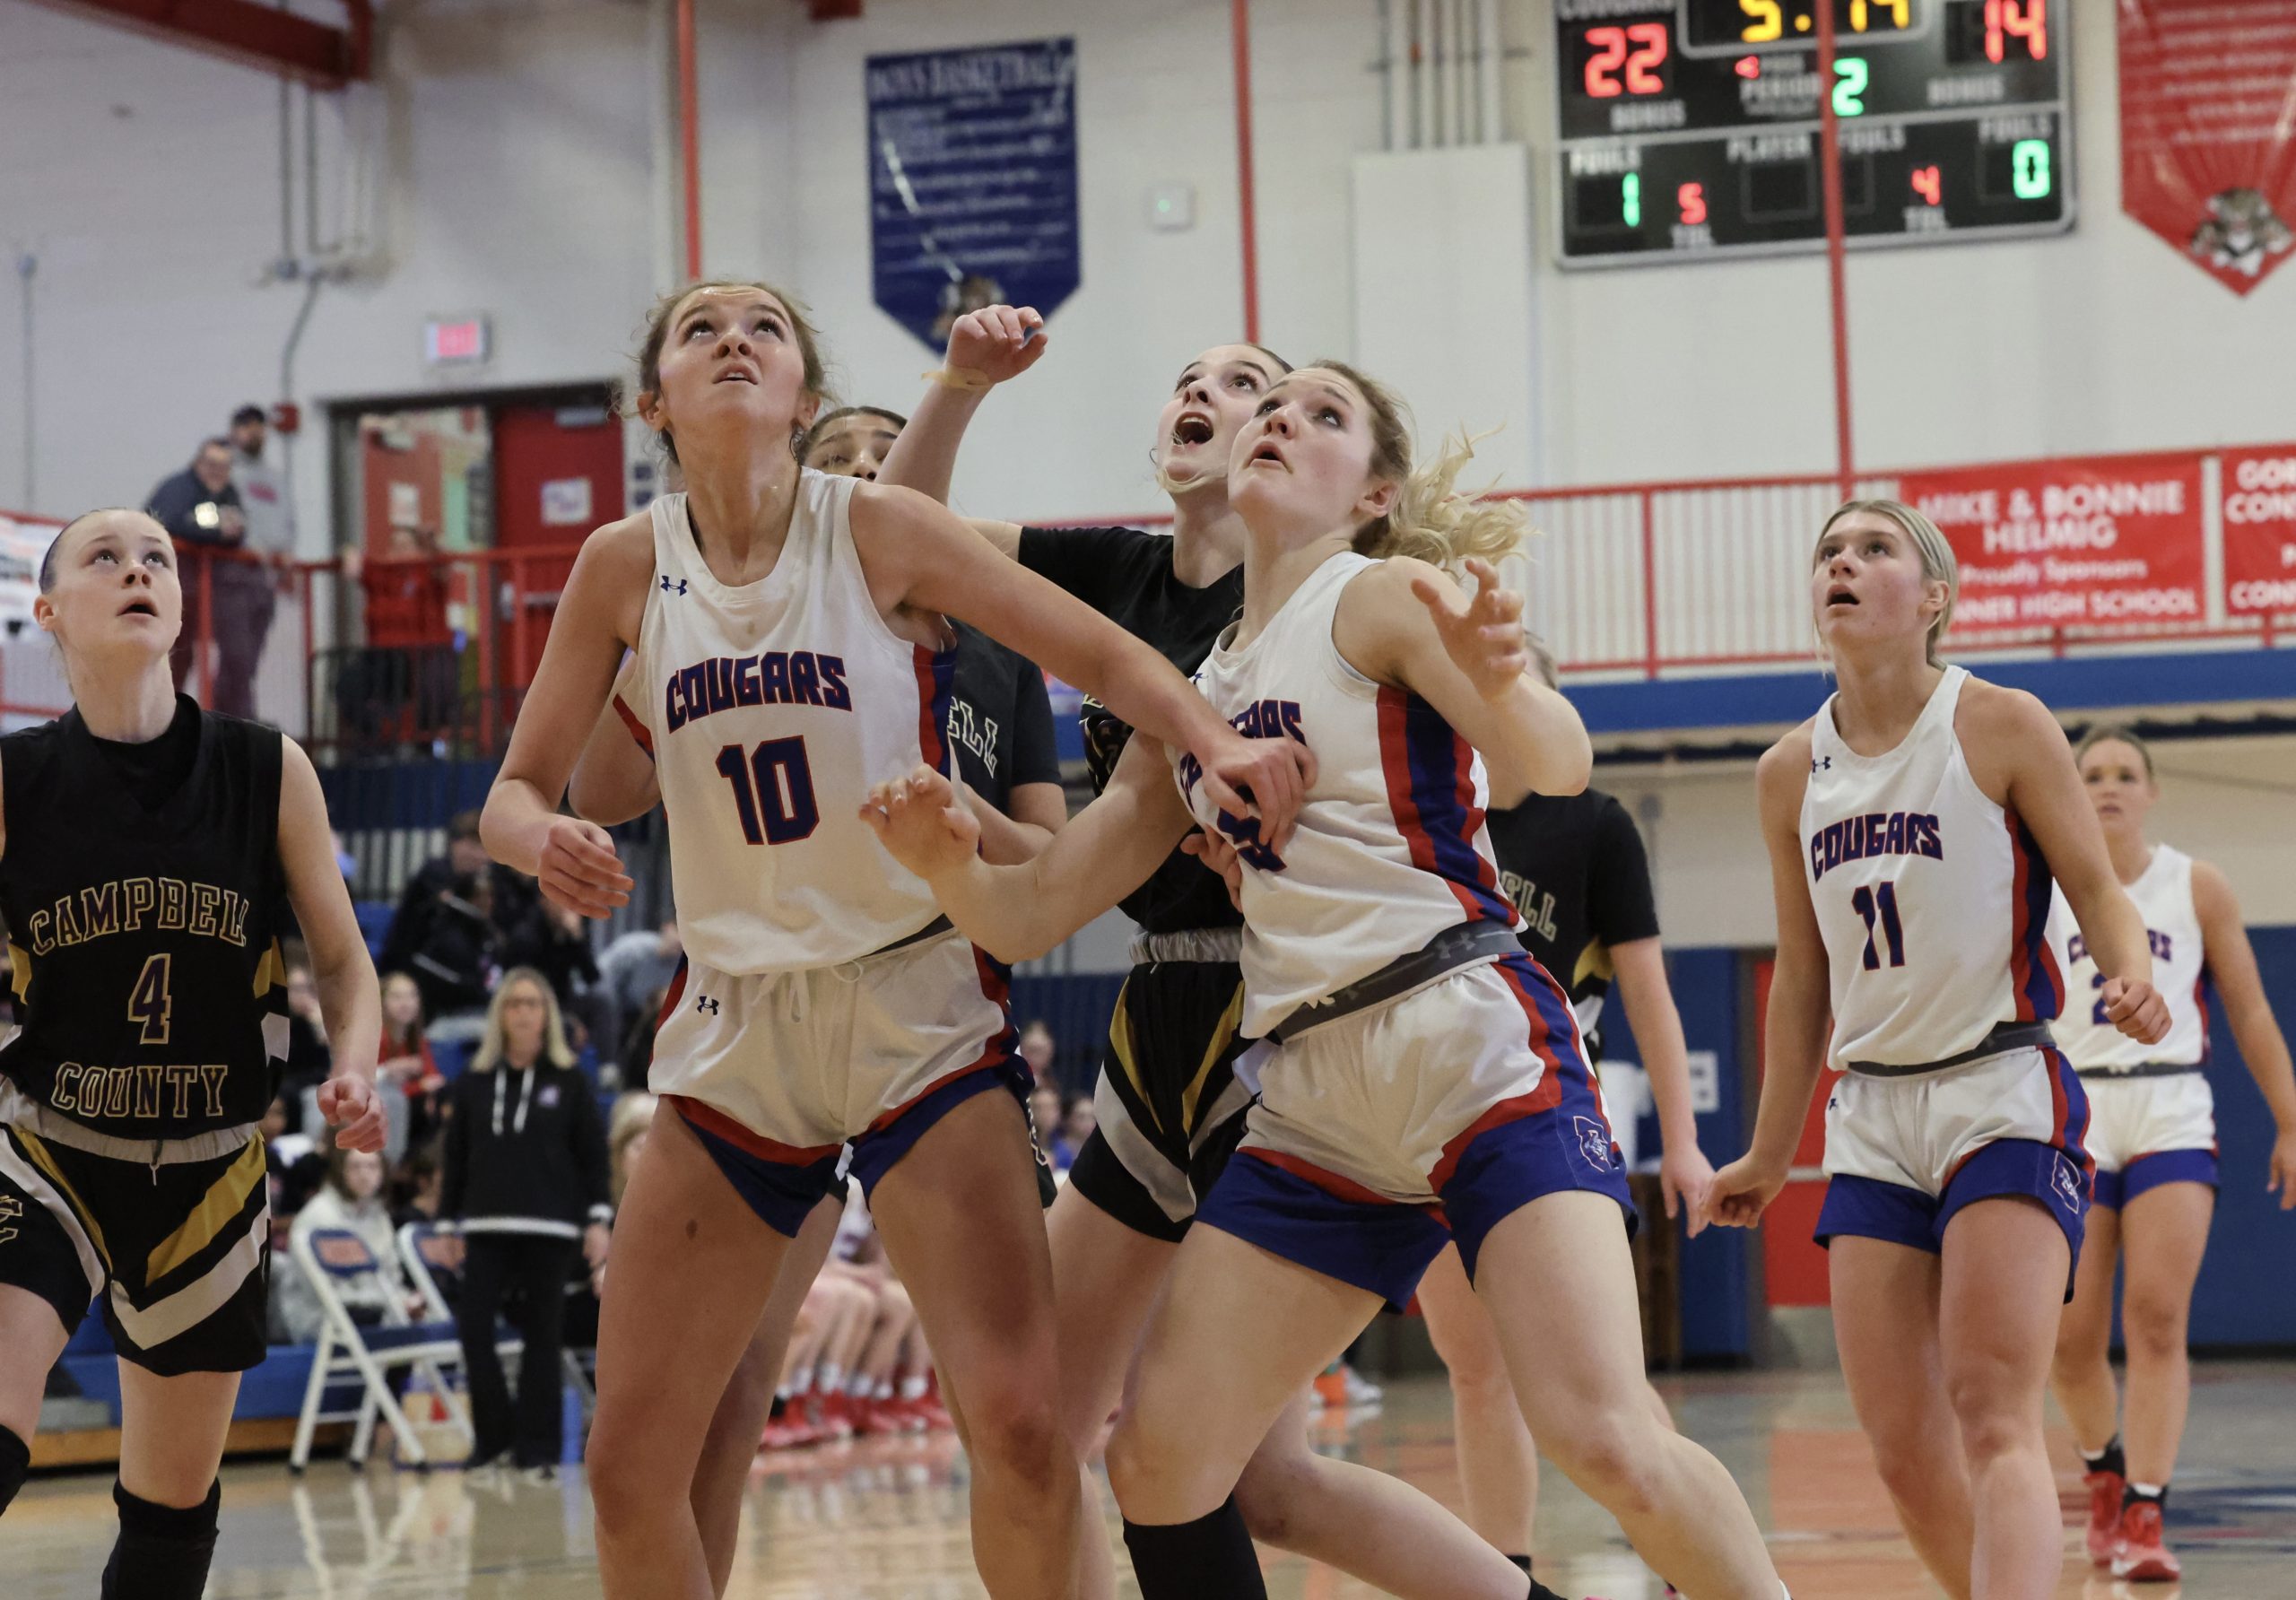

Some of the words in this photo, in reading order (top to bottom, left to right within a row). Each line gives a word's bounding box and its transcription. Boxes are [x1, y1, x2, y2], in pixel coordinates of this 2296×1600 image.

[1584, 23, 1667, 98] 22
[1984, 0, 2048, 64] 14
[1832, 57, 1868, 117] 2
[1726, 133, 1812, 162] PLAYER
[1979, 114, 2052, 143] FOULS
[1570, 143, 1641, 176] FOULS
[1911, 165, 1940, 205] 4
[2013, 139, 2050, 199] 0
[1622, 172, 1640, 228] 1
[1678, 182, 1708, 224] 5
[1917, 490, 1998, 525] MIKE
[2007, 488, 2035, 522] &
[2041, 481, 2184, 518] BONNIE
[1982, 514, 2118, 554] HELMIG
[2019, 589, 2087, 620] HIGH
[2089, 587, 2196, 617] SCHOOL
[665, 650, 853, 735] COUGARS
[715, 735, 820, 846] 10
[1810, 812, 1944, 883] COUGARS
[1851, 881, 1906, 971] 11
[127, 952, 172, 1045] 4
[50, 1061, 229, 1118] COUNTY
